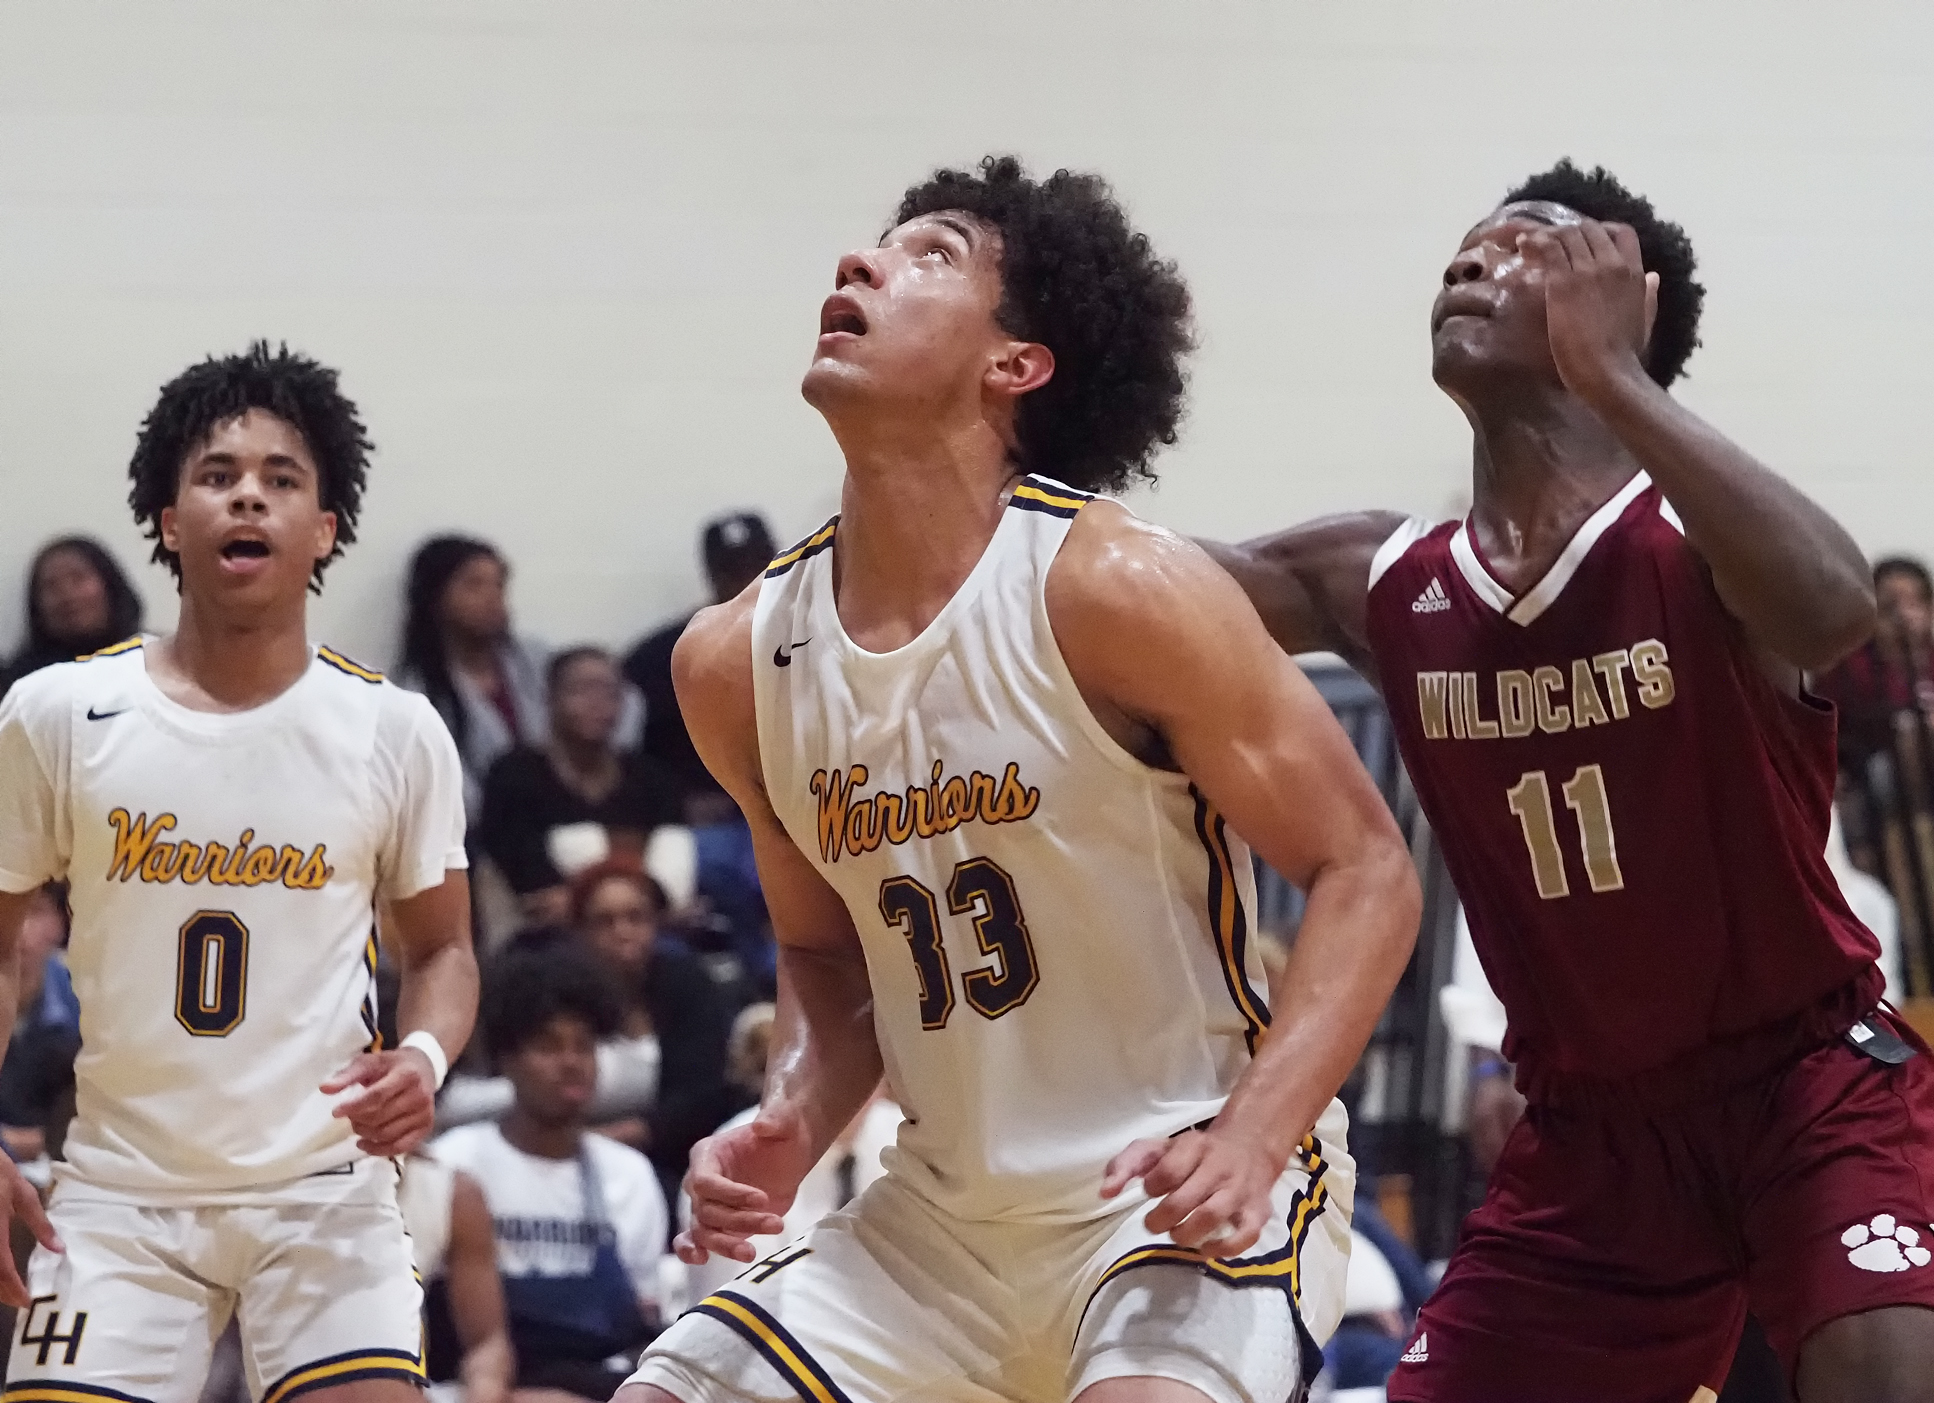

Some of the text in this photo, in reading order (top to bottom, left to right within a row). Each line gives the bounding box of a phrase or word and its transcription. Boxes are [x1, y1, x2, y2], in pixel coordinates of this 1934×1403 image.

[1412, 598, 1451, 613] adidas
[1417, 638, 1676, 740] WILDCATS
[106, 806, 335, 890] Warriors
[810, 759, 1041, 864] Warriors
[1506, 763, 1625, 900] 11
[174, 909, 250, 1038] 0
[879, 855, 1041, 1032] 33
